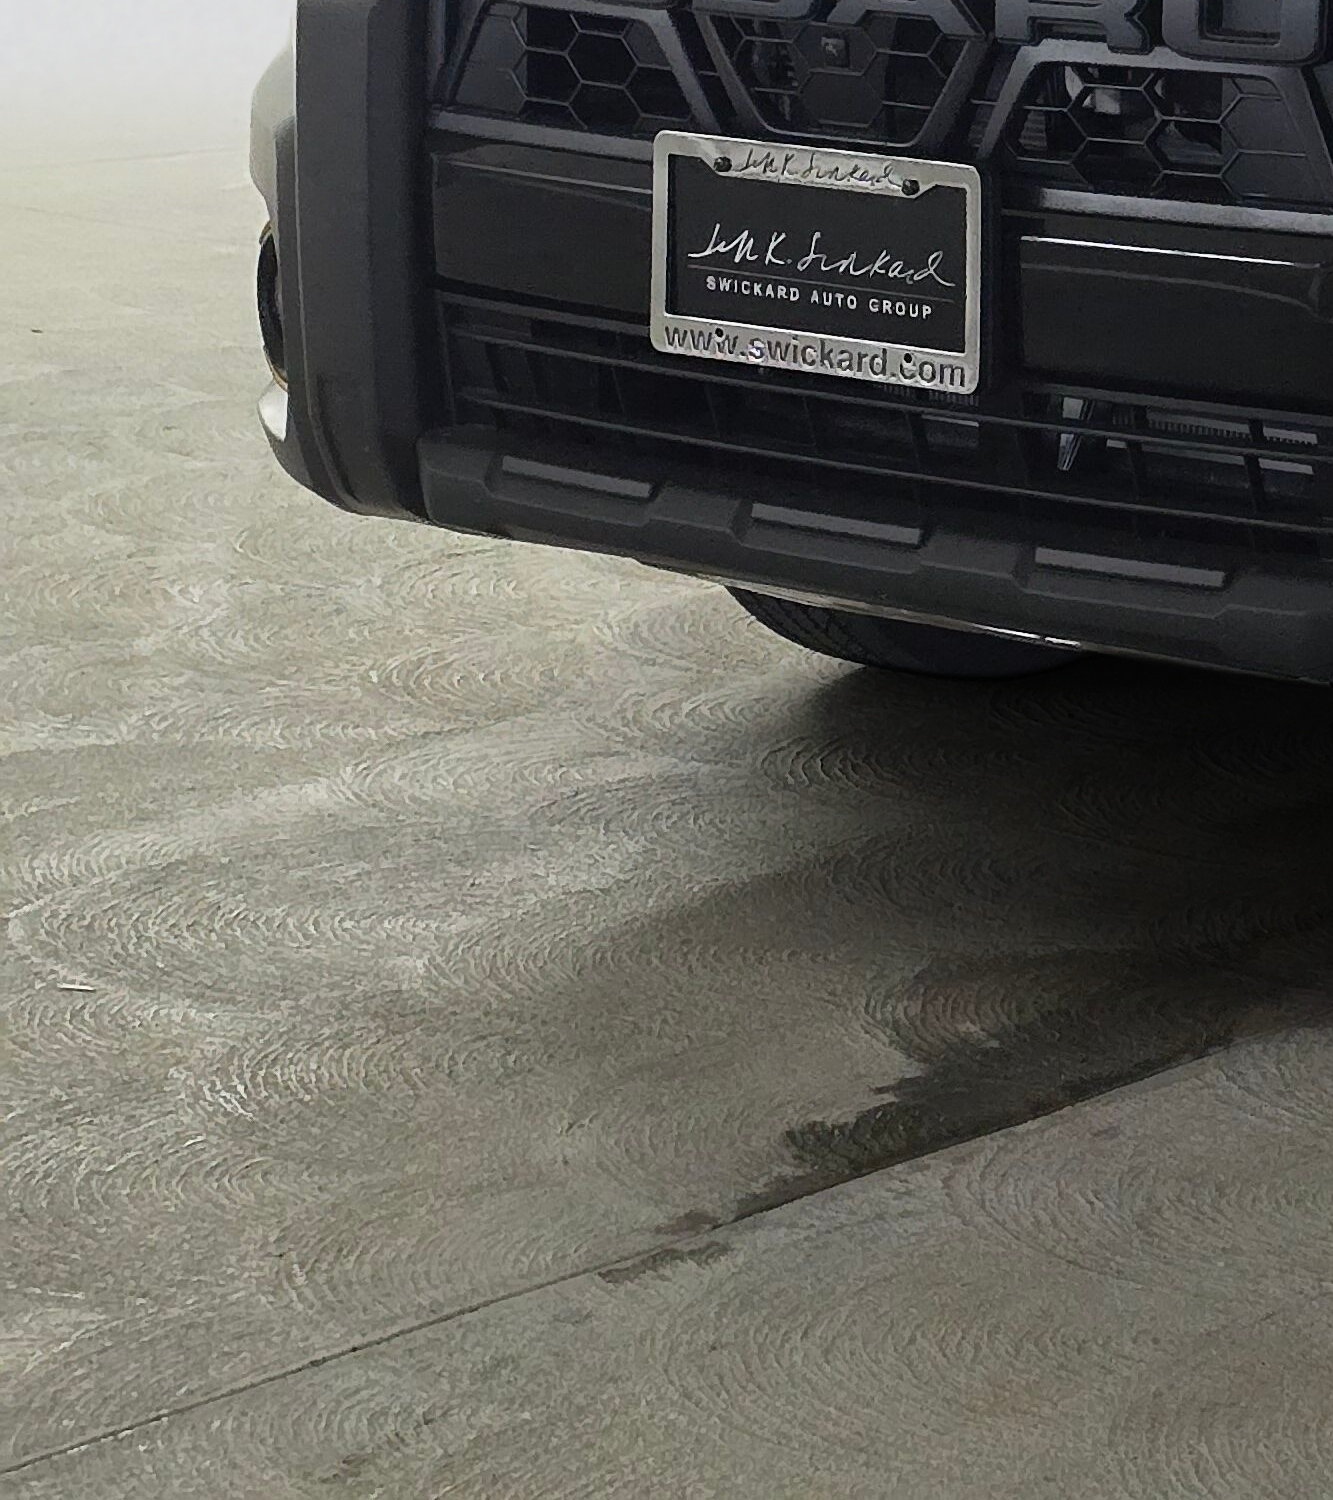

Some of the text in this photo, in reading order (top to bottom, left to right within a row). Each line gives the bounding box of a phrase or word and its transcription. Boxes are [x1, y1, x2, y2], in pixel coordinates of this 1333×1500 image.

[706, 274, 933, 320] SWICKARD AUTO GROUP
[664, 325, 967, 388] www.swickard.com
